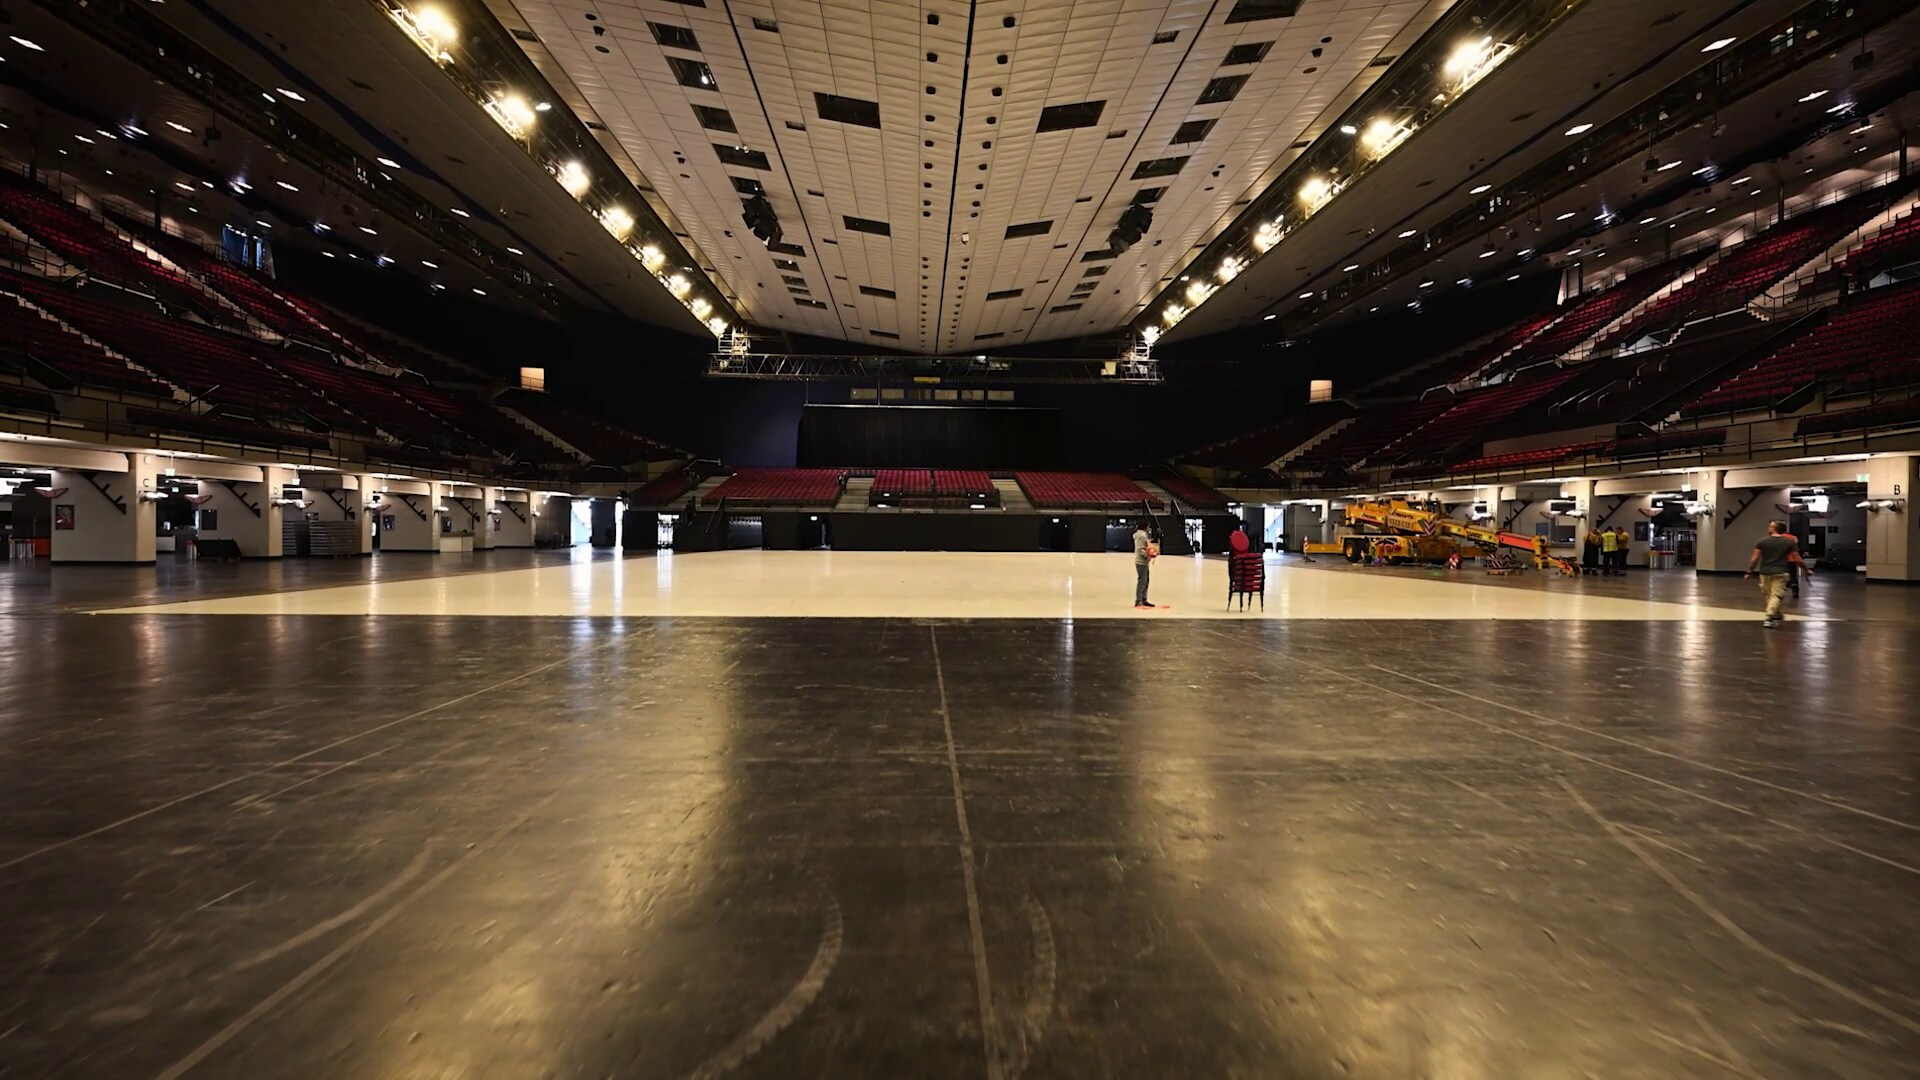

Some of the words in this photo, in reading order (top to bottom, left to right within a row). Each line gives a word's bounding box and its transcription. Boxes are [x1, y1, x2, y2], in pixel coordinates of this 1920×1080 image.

[143, 478, 149, 488] C
[1894, 484, 1901, 495] B
[1703, 493, 1710, 502] C
